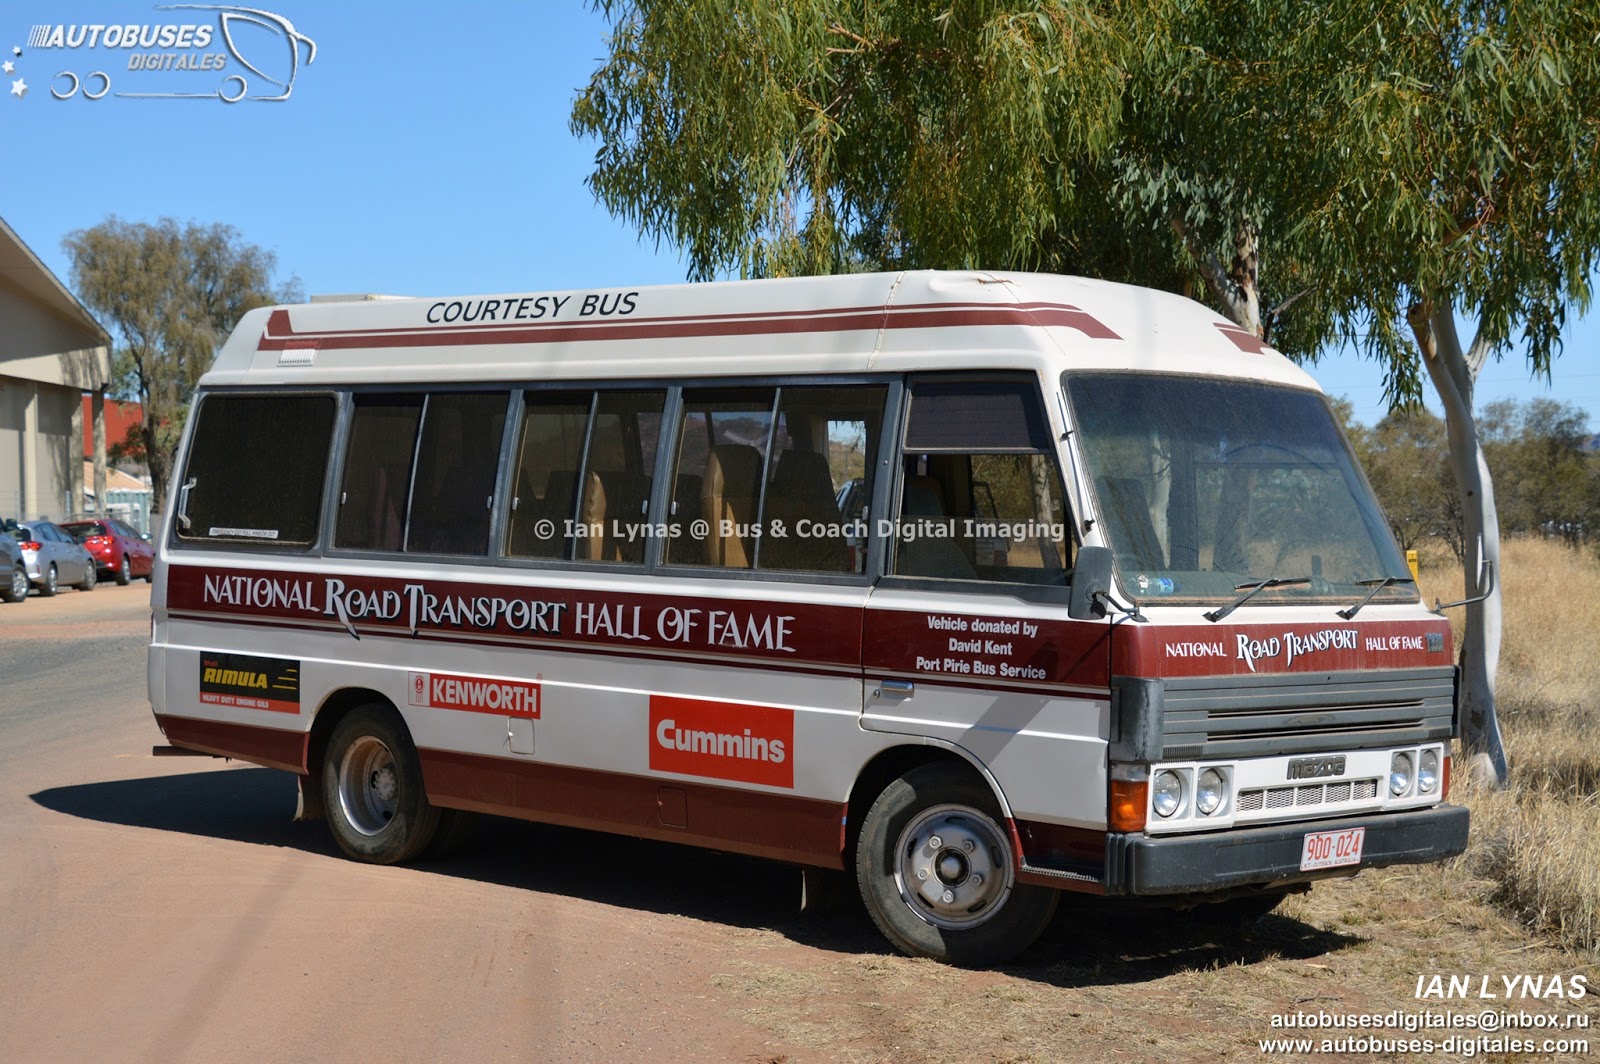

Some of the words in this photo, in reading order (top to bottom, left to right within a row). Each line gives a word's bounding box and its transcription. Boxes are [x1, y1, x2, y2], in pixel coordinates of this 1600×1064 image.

[426, 295, 572, 324] COURTESY
[579, 292, 639, 317] BUS
[203, 574, 320, 612] NATIONAL
[323, 579, 401, 640] ROAD
[404, 584, 567, 639] TRANSPORT
[575, 602, 651, 641] HALL
[657, 606, 702, 643] OF
[707, 610, 796, 653] FAME
[927, 616, 968, 631] Vehicle
[971, 618, 1020, 635] donated
[1022, 621, 1039, 638] by
[948, 638, 981, 653] David
[984, 640, 1013, 655] Kent
[1165, 642, 1227, 657] NATIONAL
[1236, 634, 1281, 673] ROAD
[1284, 629, 1358, 667] TRANSPORT
[1365, 637, 1388, 651] HALL
[1389, 637, 1401, 649] OF
[1402, 636, 1424, 649] FAME
[203, 667, 268, 689] RIMULA
[916, 656, 940, 671] Port
[943, 658, 970, 673] Pirie
[973, 660, 996, 675] Bus
[1000, 662, 1046, 679] Service
[203, 694, 220, 703] HEAVY
[220, 696, 236, 705] DUTY
[236, 697, 256, 708] ENGINE
[257, 700, 269, 709] OILS
[433, 678, 537, 712] KENWORTH
[656, 719, 786, 764] Cummins
